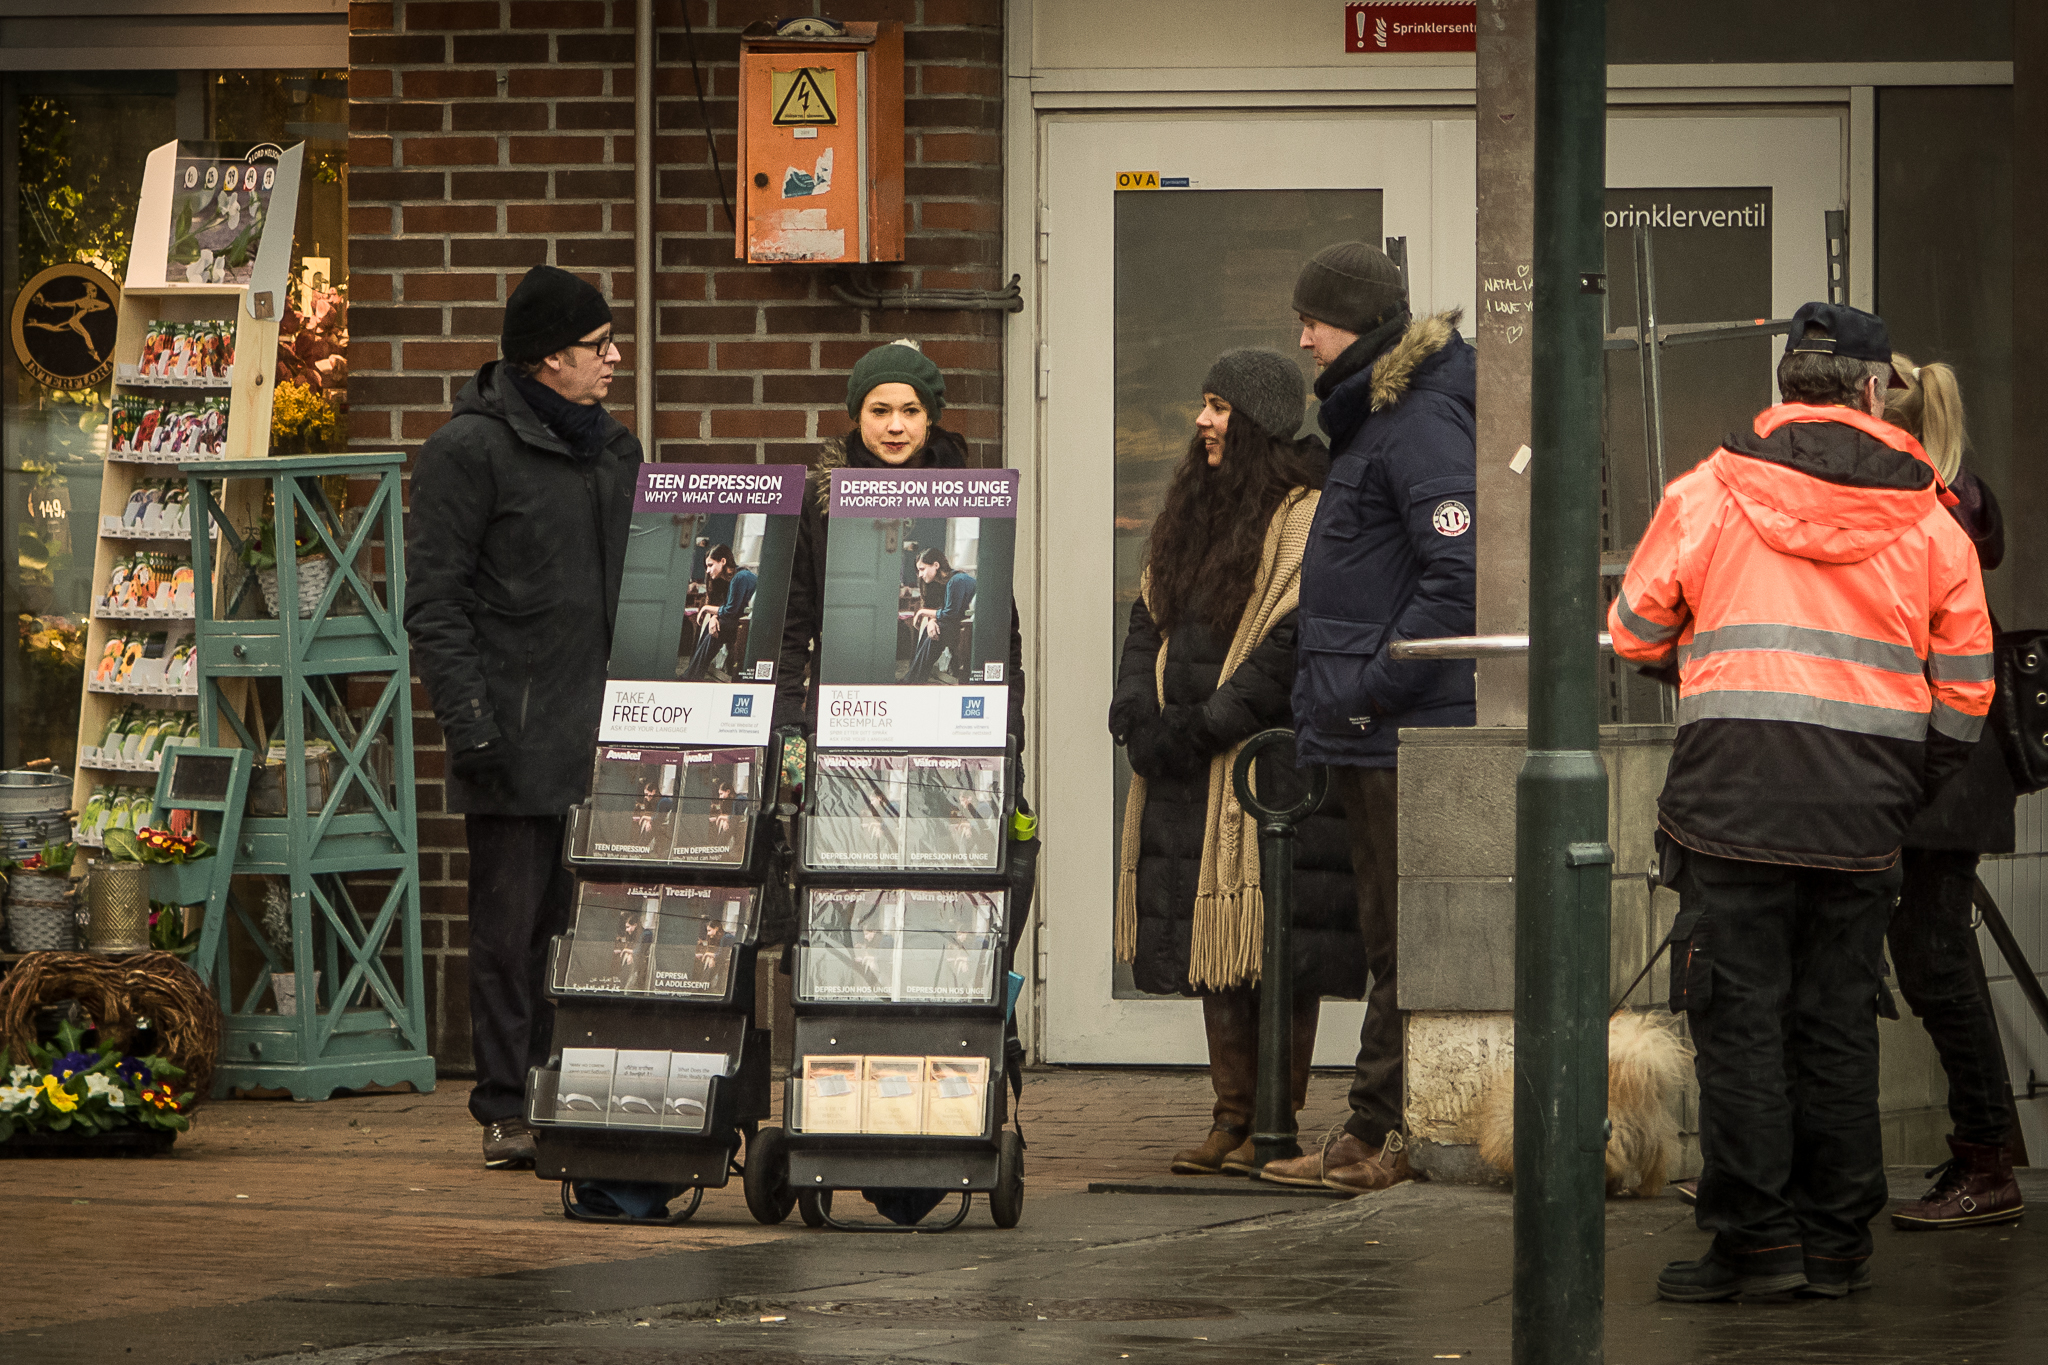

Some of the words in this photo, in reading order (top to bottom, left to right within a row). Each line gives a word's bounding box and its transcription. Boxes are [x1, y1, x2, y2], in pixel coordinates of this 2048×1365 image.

[1119, 173, 1156, 187] OVA
[1604, 203, 1765, 228] prinklerventil
[1487, 300, 1491, 312] I
[1495, 301, 1521, 314] LOVE
[26, 359, 113, 389] INTERFLORA
[648, 474, 685, 489] TEEN
[688, 474, 782, 490] DEPRESSION
[840, 480, 928, 494] DEPRESJON
[932, 480, 963, 494] HOS
[968, 480, 1009, 494] UNGE
[644, 490, 678, 503] WHY?
[682, 491, 715, 503] WHAT
[718, 491, 743, 504] CAN
[746, 492, 782, 504] HELP?
[840, 496, 902, 507] HVORFOR?
[907, 496, 930, 507] HVA
[934, 496, 958, 507] KAN
[963, 496, 1012, 507] HJELPE?
[616, 692, 645, 704] TAKE
[647, 692, 656, 704] A
[831, 690, 844, 699] TA
[847, 690, 860, 699] ET
[735, 698, 749, 707] JW
[965, 699, 981, 709] JW
[830, 700, 888, 716] GRATIS
[612, 705, 649, 723] FREE
[652, 706, 692, 724] COPY
[829, 718, 893, 728] EKSEMPLAR
[606, 750, 641, 761] Awake!
[684, 753, 712, 763] wake!
[939, 759, 962, 769] opp!
[594, 843, 610, 851] TEEN
[611, 844, 650, 853] DEPRESSION
[674, 847, 689, 855] TEEN
[690, 846, 730, 855] DEPRESSION
[820, 852, 862, 860] DEPRESJON
[863, 852, 878, 860] HOS
[880, 852, 898, 860] UNGE
[910, 852, 950, 861] DEPRESJON
[952, 853, 967, 861] HOS
[968, 853, 988, 861] UNGE
[656, 971, 688, 980] DEPRESIA
[654, 979, 665, 987] LA
[814, 985, 855, 993] DEPRESJON
[873, 986, 892, 994] UNGE
[906, 986, 948, 994] DEPRESJON
[965, 987, 984, 995] UNGE
